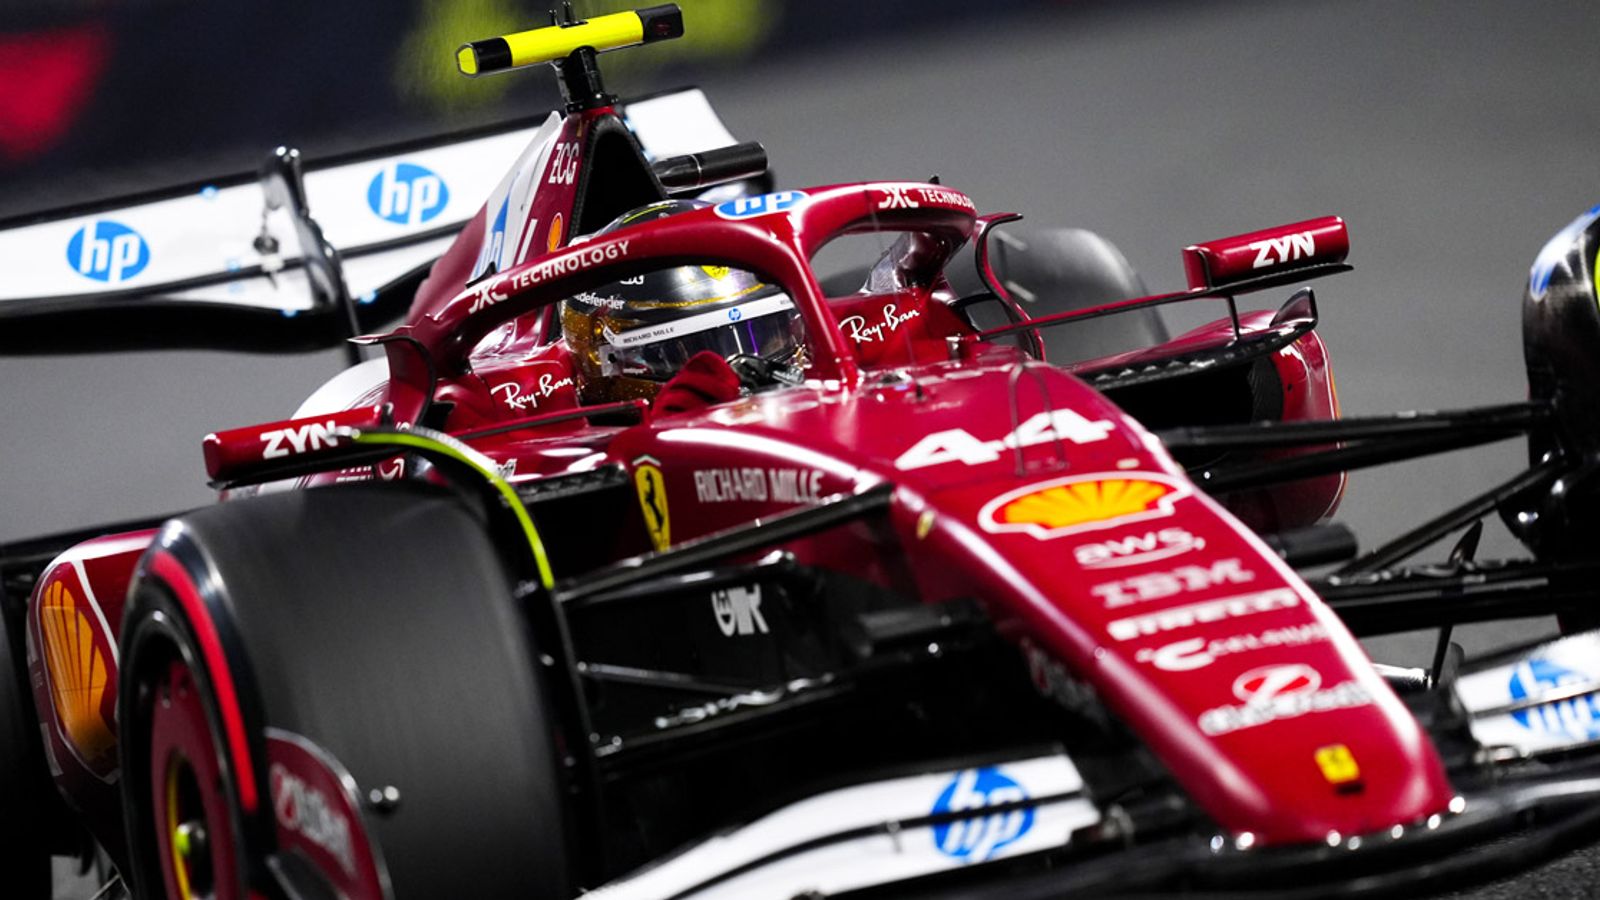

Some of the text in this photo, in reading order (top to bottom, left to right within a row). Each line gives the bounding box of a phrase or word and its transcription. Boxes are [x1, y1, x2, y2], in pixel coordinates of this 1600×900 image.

[380, 163, 440, 224] hp
[79, 222, 141, 282] hp
[510, 240, 630, 290] TECHNOLOGY
[1249, 231, 1316, 268] ZYN
[839, 303, 920, 344] Ray-Ban
[490, 374, 575, 410] Ray-Ban
[260, 420, 339, 460] ZYN
[895, 408, 1115, 471] 44
[693, 467, 825, 503] RICHARD MILLE
[1091, 558, 1255, 609] IBM
